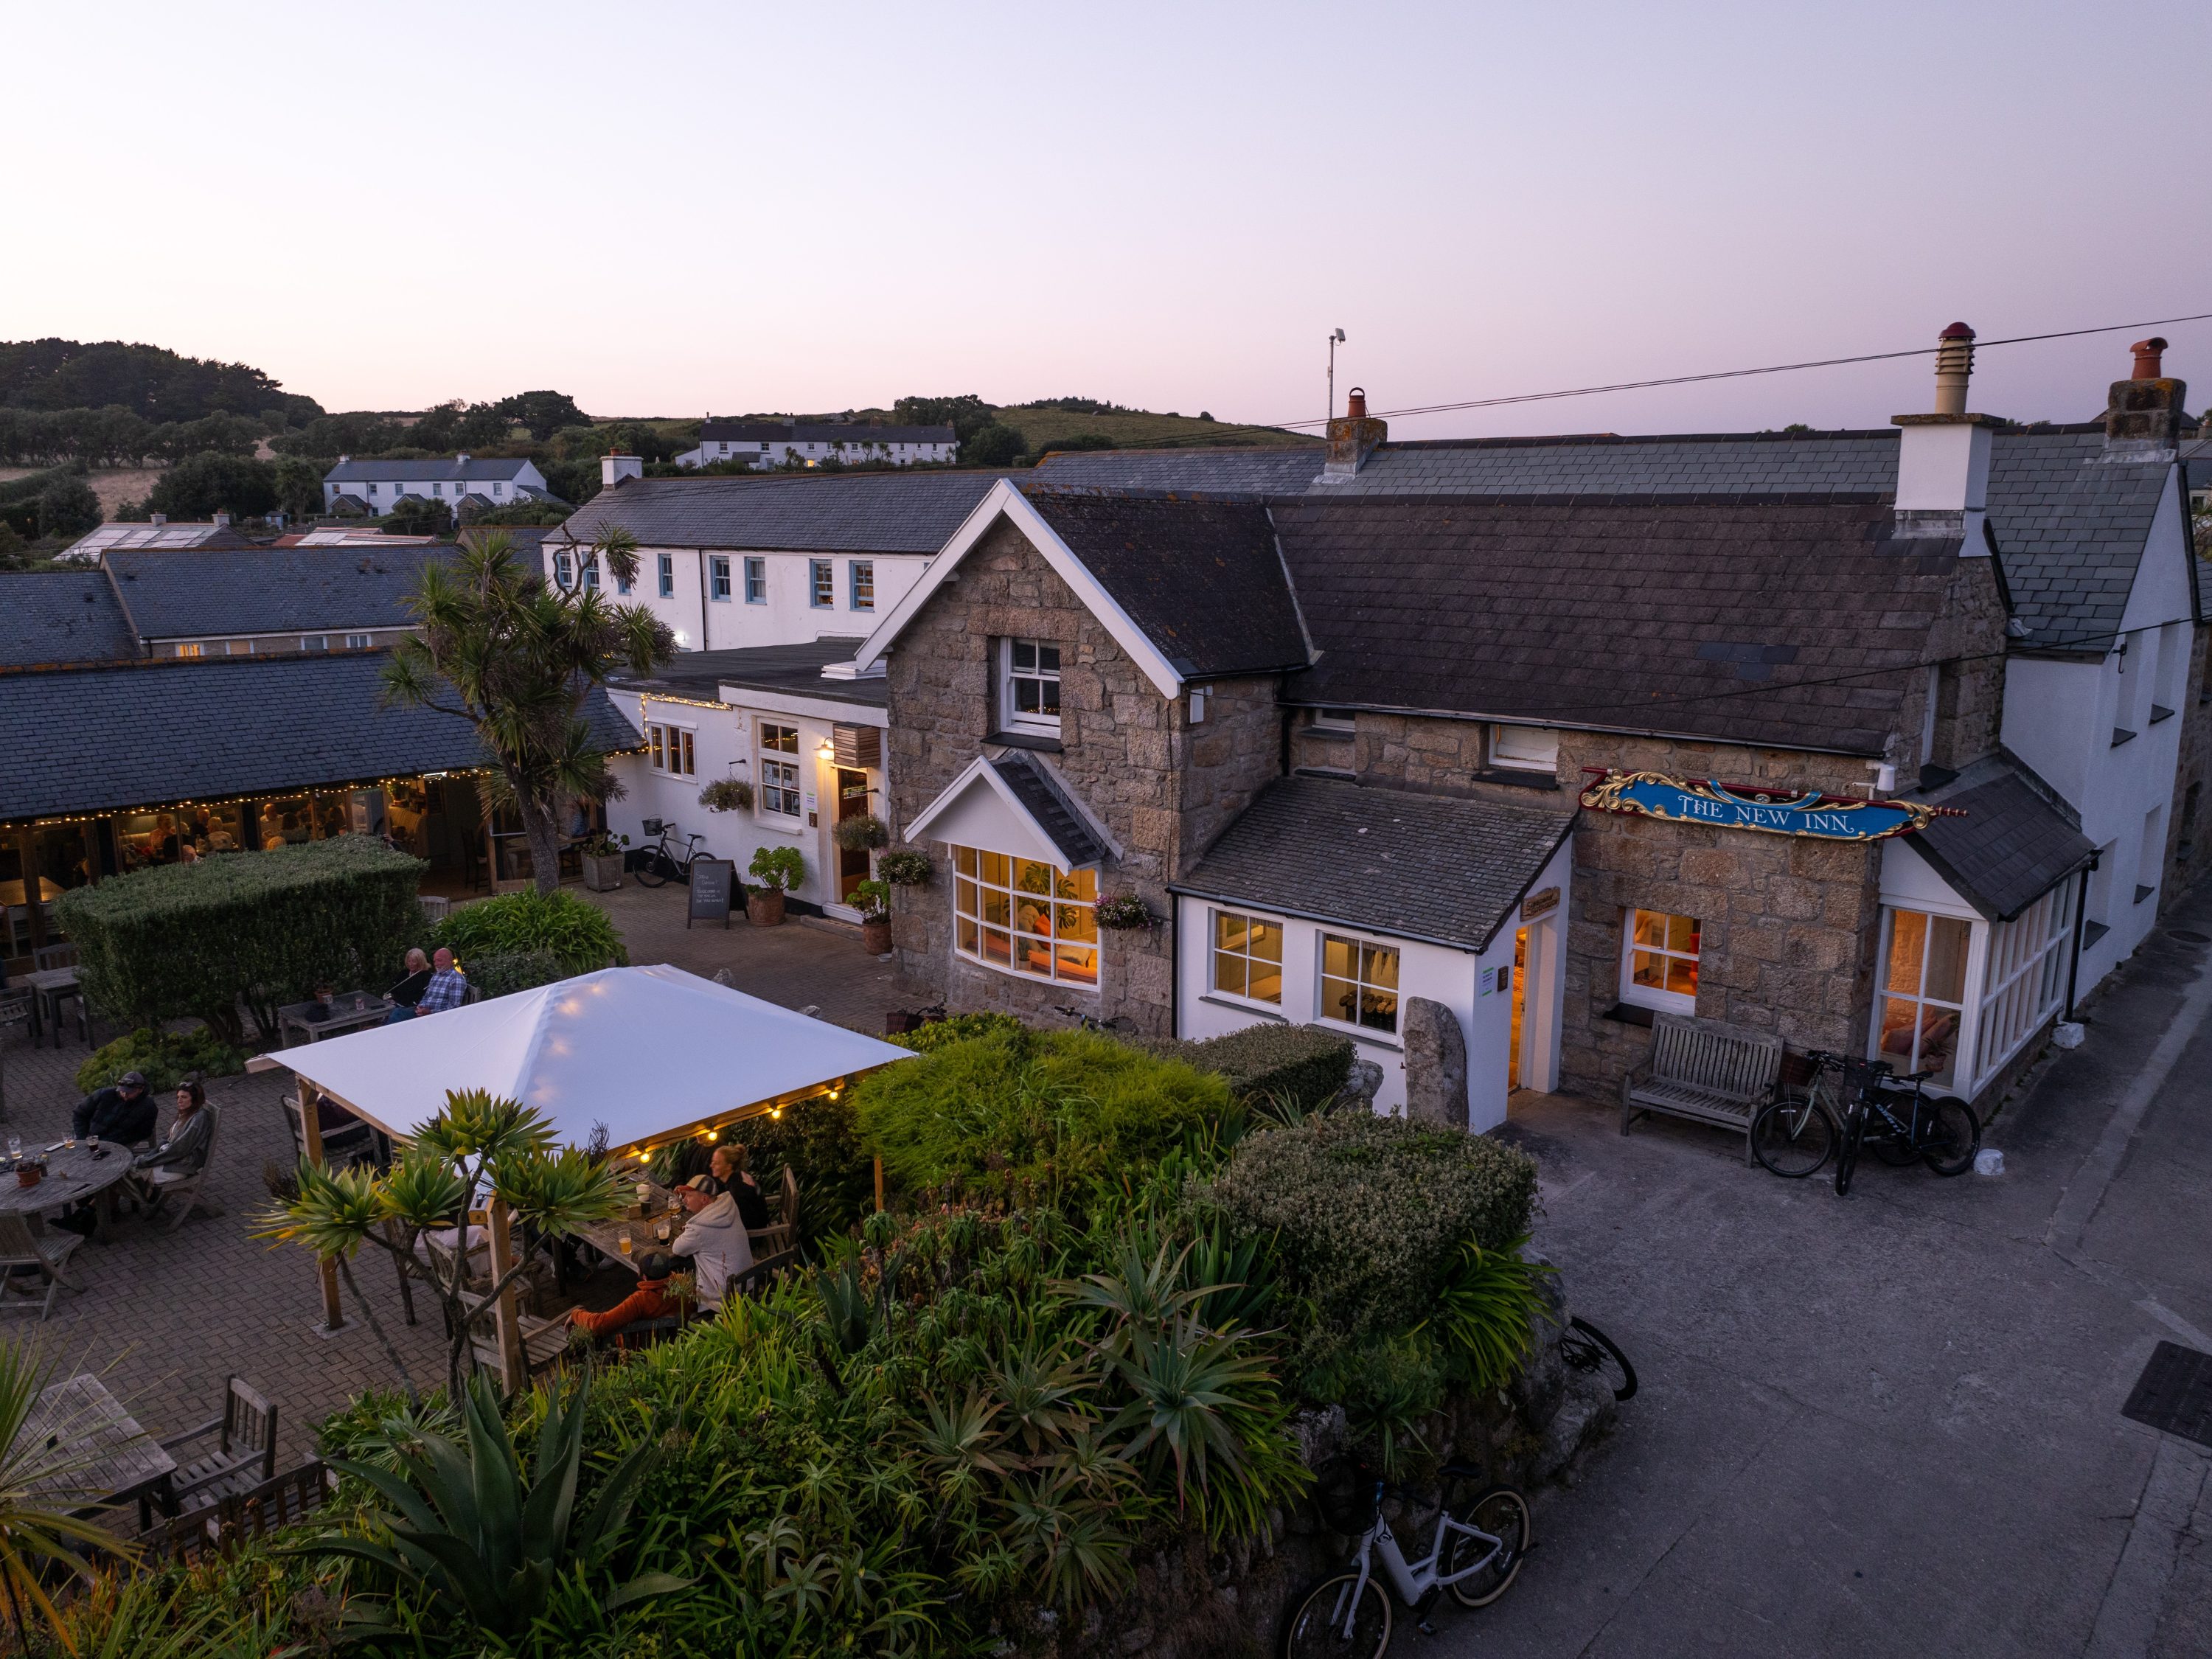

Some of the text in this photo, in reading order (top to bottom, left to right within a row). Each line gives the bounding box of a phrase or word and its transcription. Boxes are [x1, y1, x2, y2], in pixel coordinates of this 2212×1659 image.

[1677, 795, 1854, 833] THE NEW INN
